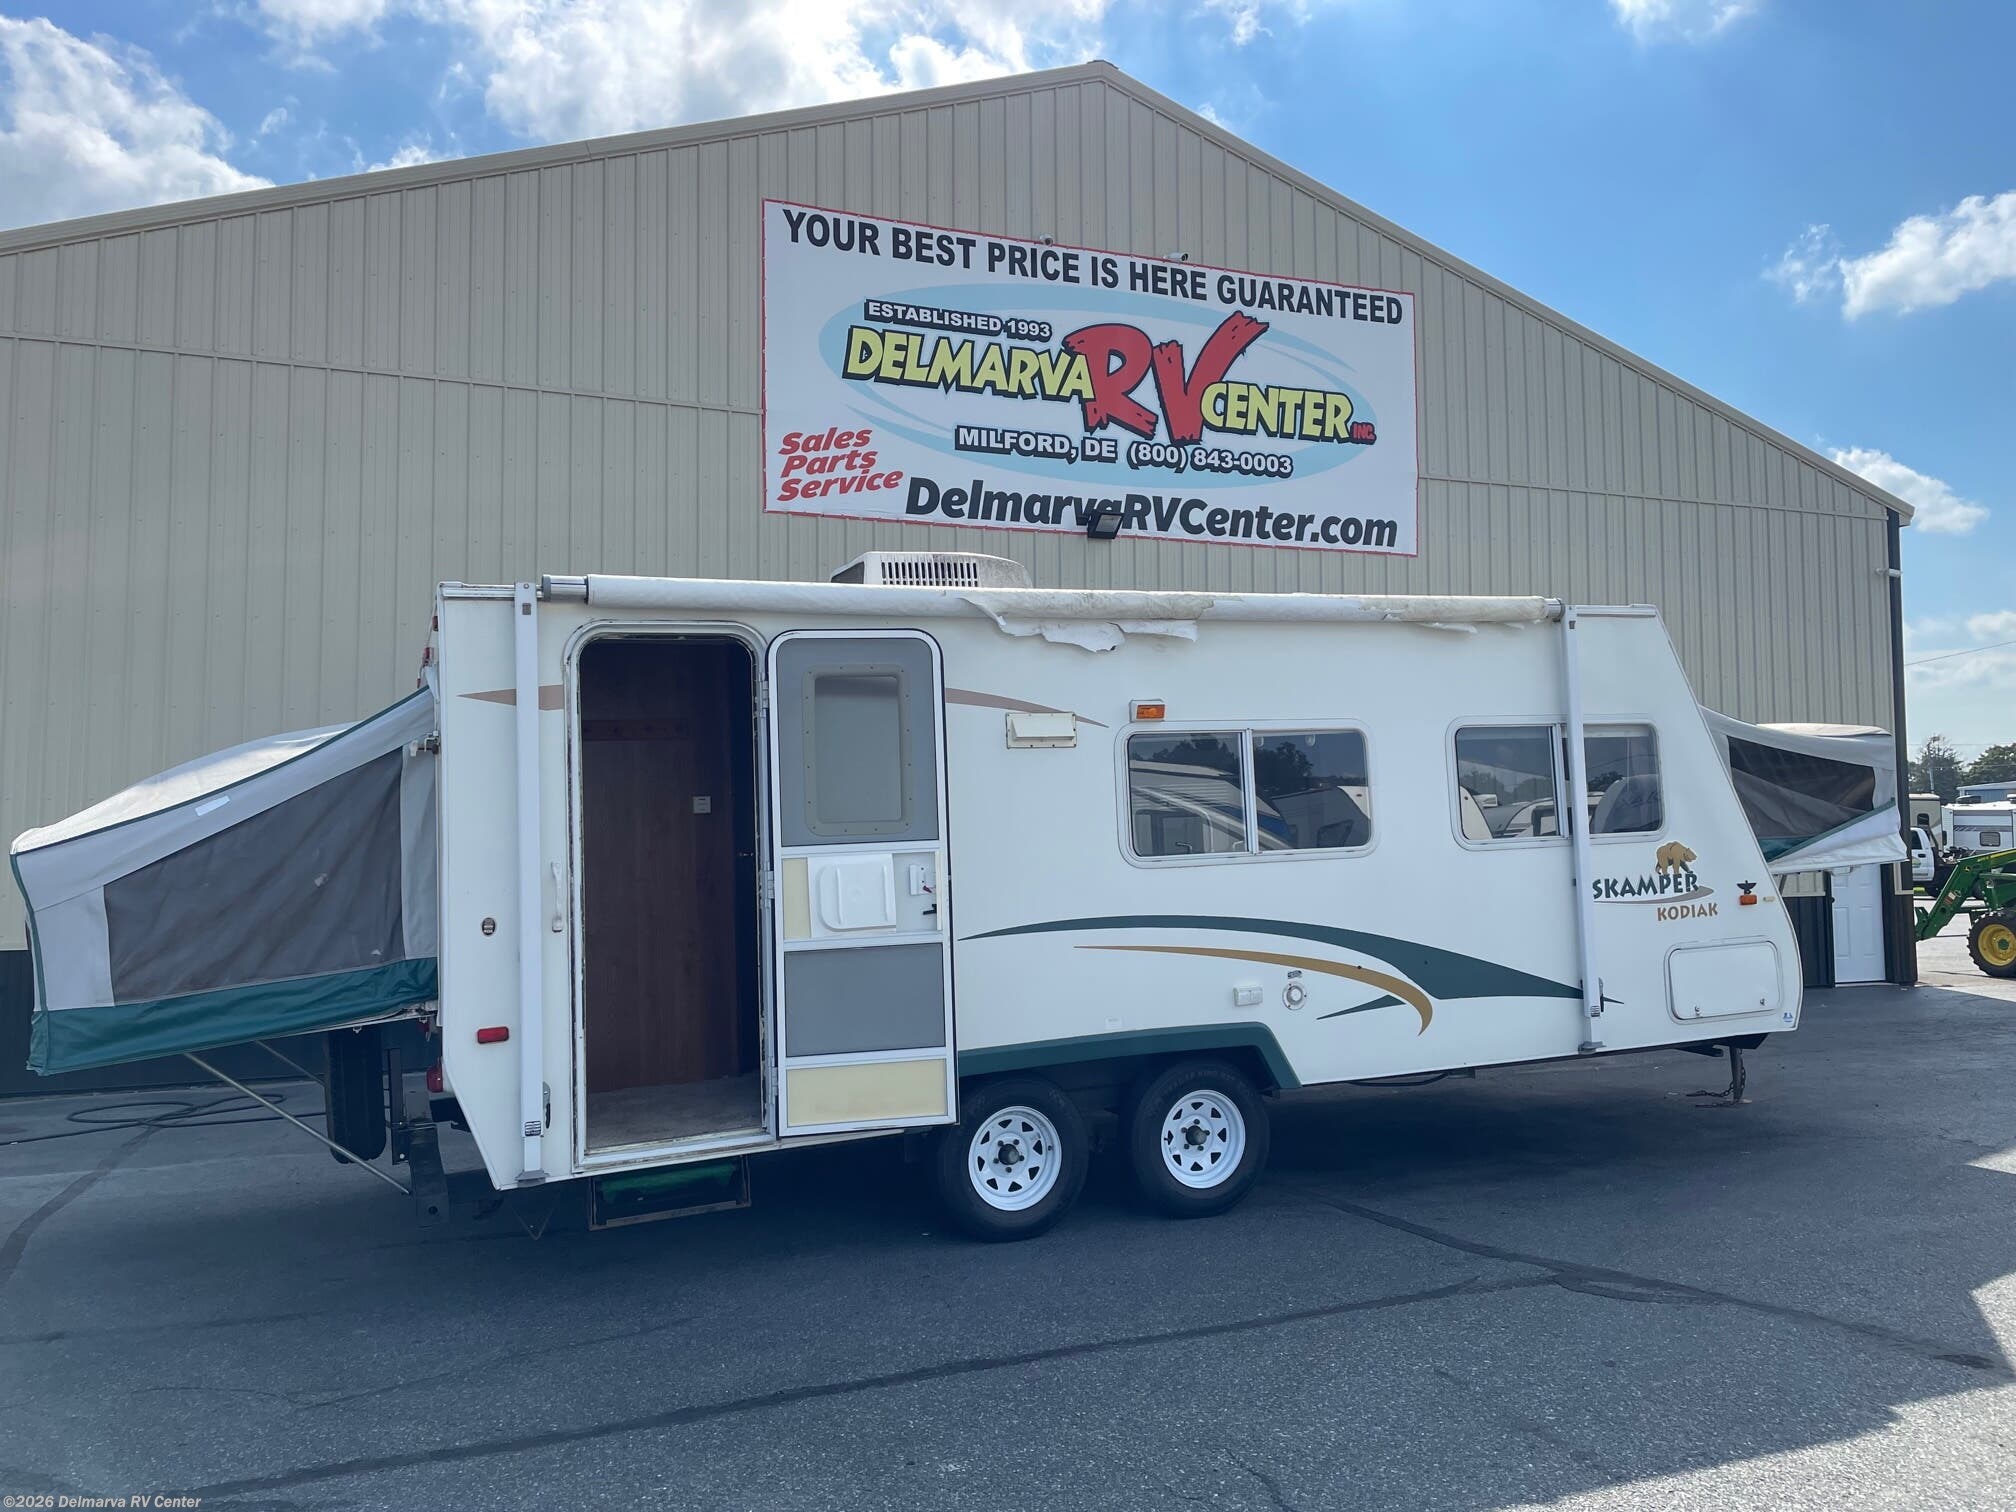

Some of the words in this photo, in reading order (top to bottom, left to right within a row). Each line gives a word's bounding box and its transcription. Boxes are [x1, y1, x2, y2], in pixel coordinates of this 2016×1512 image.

[782, 209, 881, 256] YOUR
[892, 227, 977, 269] BEST
[987, 241, 1081, 284] PRICE
[1091, 256, 1119, 289] IS
[1129, 261, 1207, 301] HERE
[1217, 274, 1403, 325] GUARANTEED
[867, 301, 1003, 334] ESTABLISHED
[1006, 319, 1052, 339] 1993
[845, 325, 1096, 402] DELMARVA
[1063, 311, 1270, 446] RV
[1200, 381, 1354, 442] CENTER
[1352, 422, 1376, 442] INC.
[779, 427, 873, 455] Sales
[957, 426, 1078, 459] MILFORD,
[1084, 438, 1117, 459] DE
[1129, 441, 1187, 469] (800)
[1193, 449, 1293, 475] 843-0003
[781, 449, 878, 478] Parts
[777, 469, 904, 502] Service
[1592, 872, 1699, 899] SKAMPER
[1657, 902, 1719, 922] KODIAK
